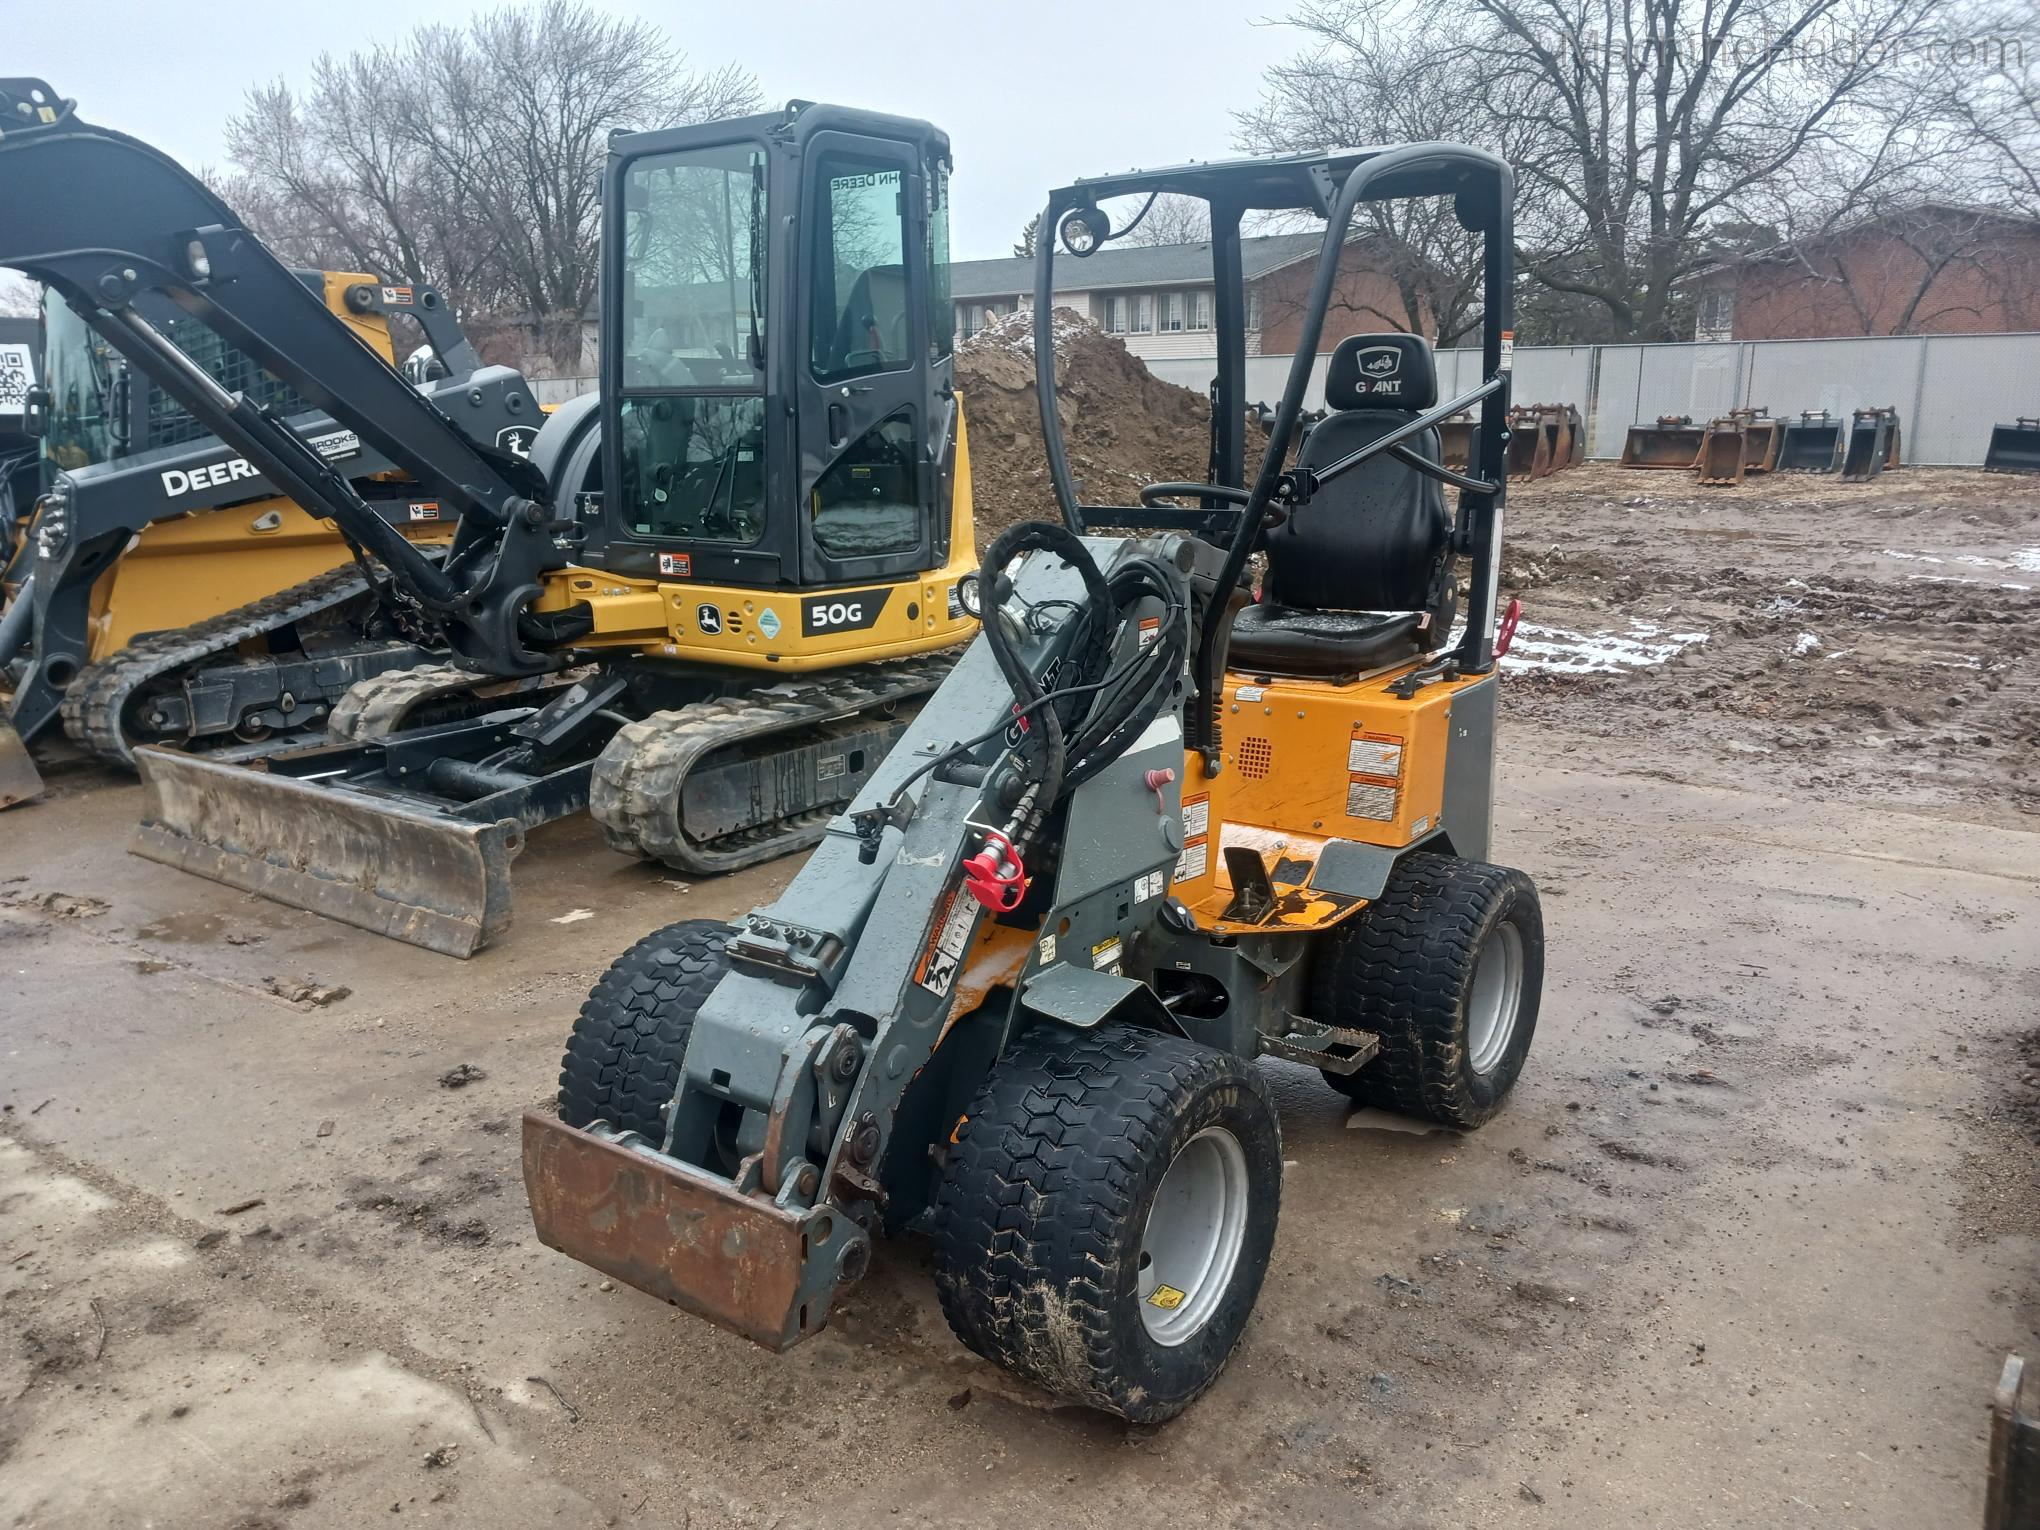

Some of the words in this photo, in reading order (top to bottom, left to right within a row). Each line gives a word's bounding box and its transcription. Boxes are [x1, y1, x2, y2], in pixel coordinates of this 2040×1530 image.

[1355, 380, 1402, 393] GIANT
[812, 603, 862, 628] 50G
[1004, 656, 1061, 748] GINT
